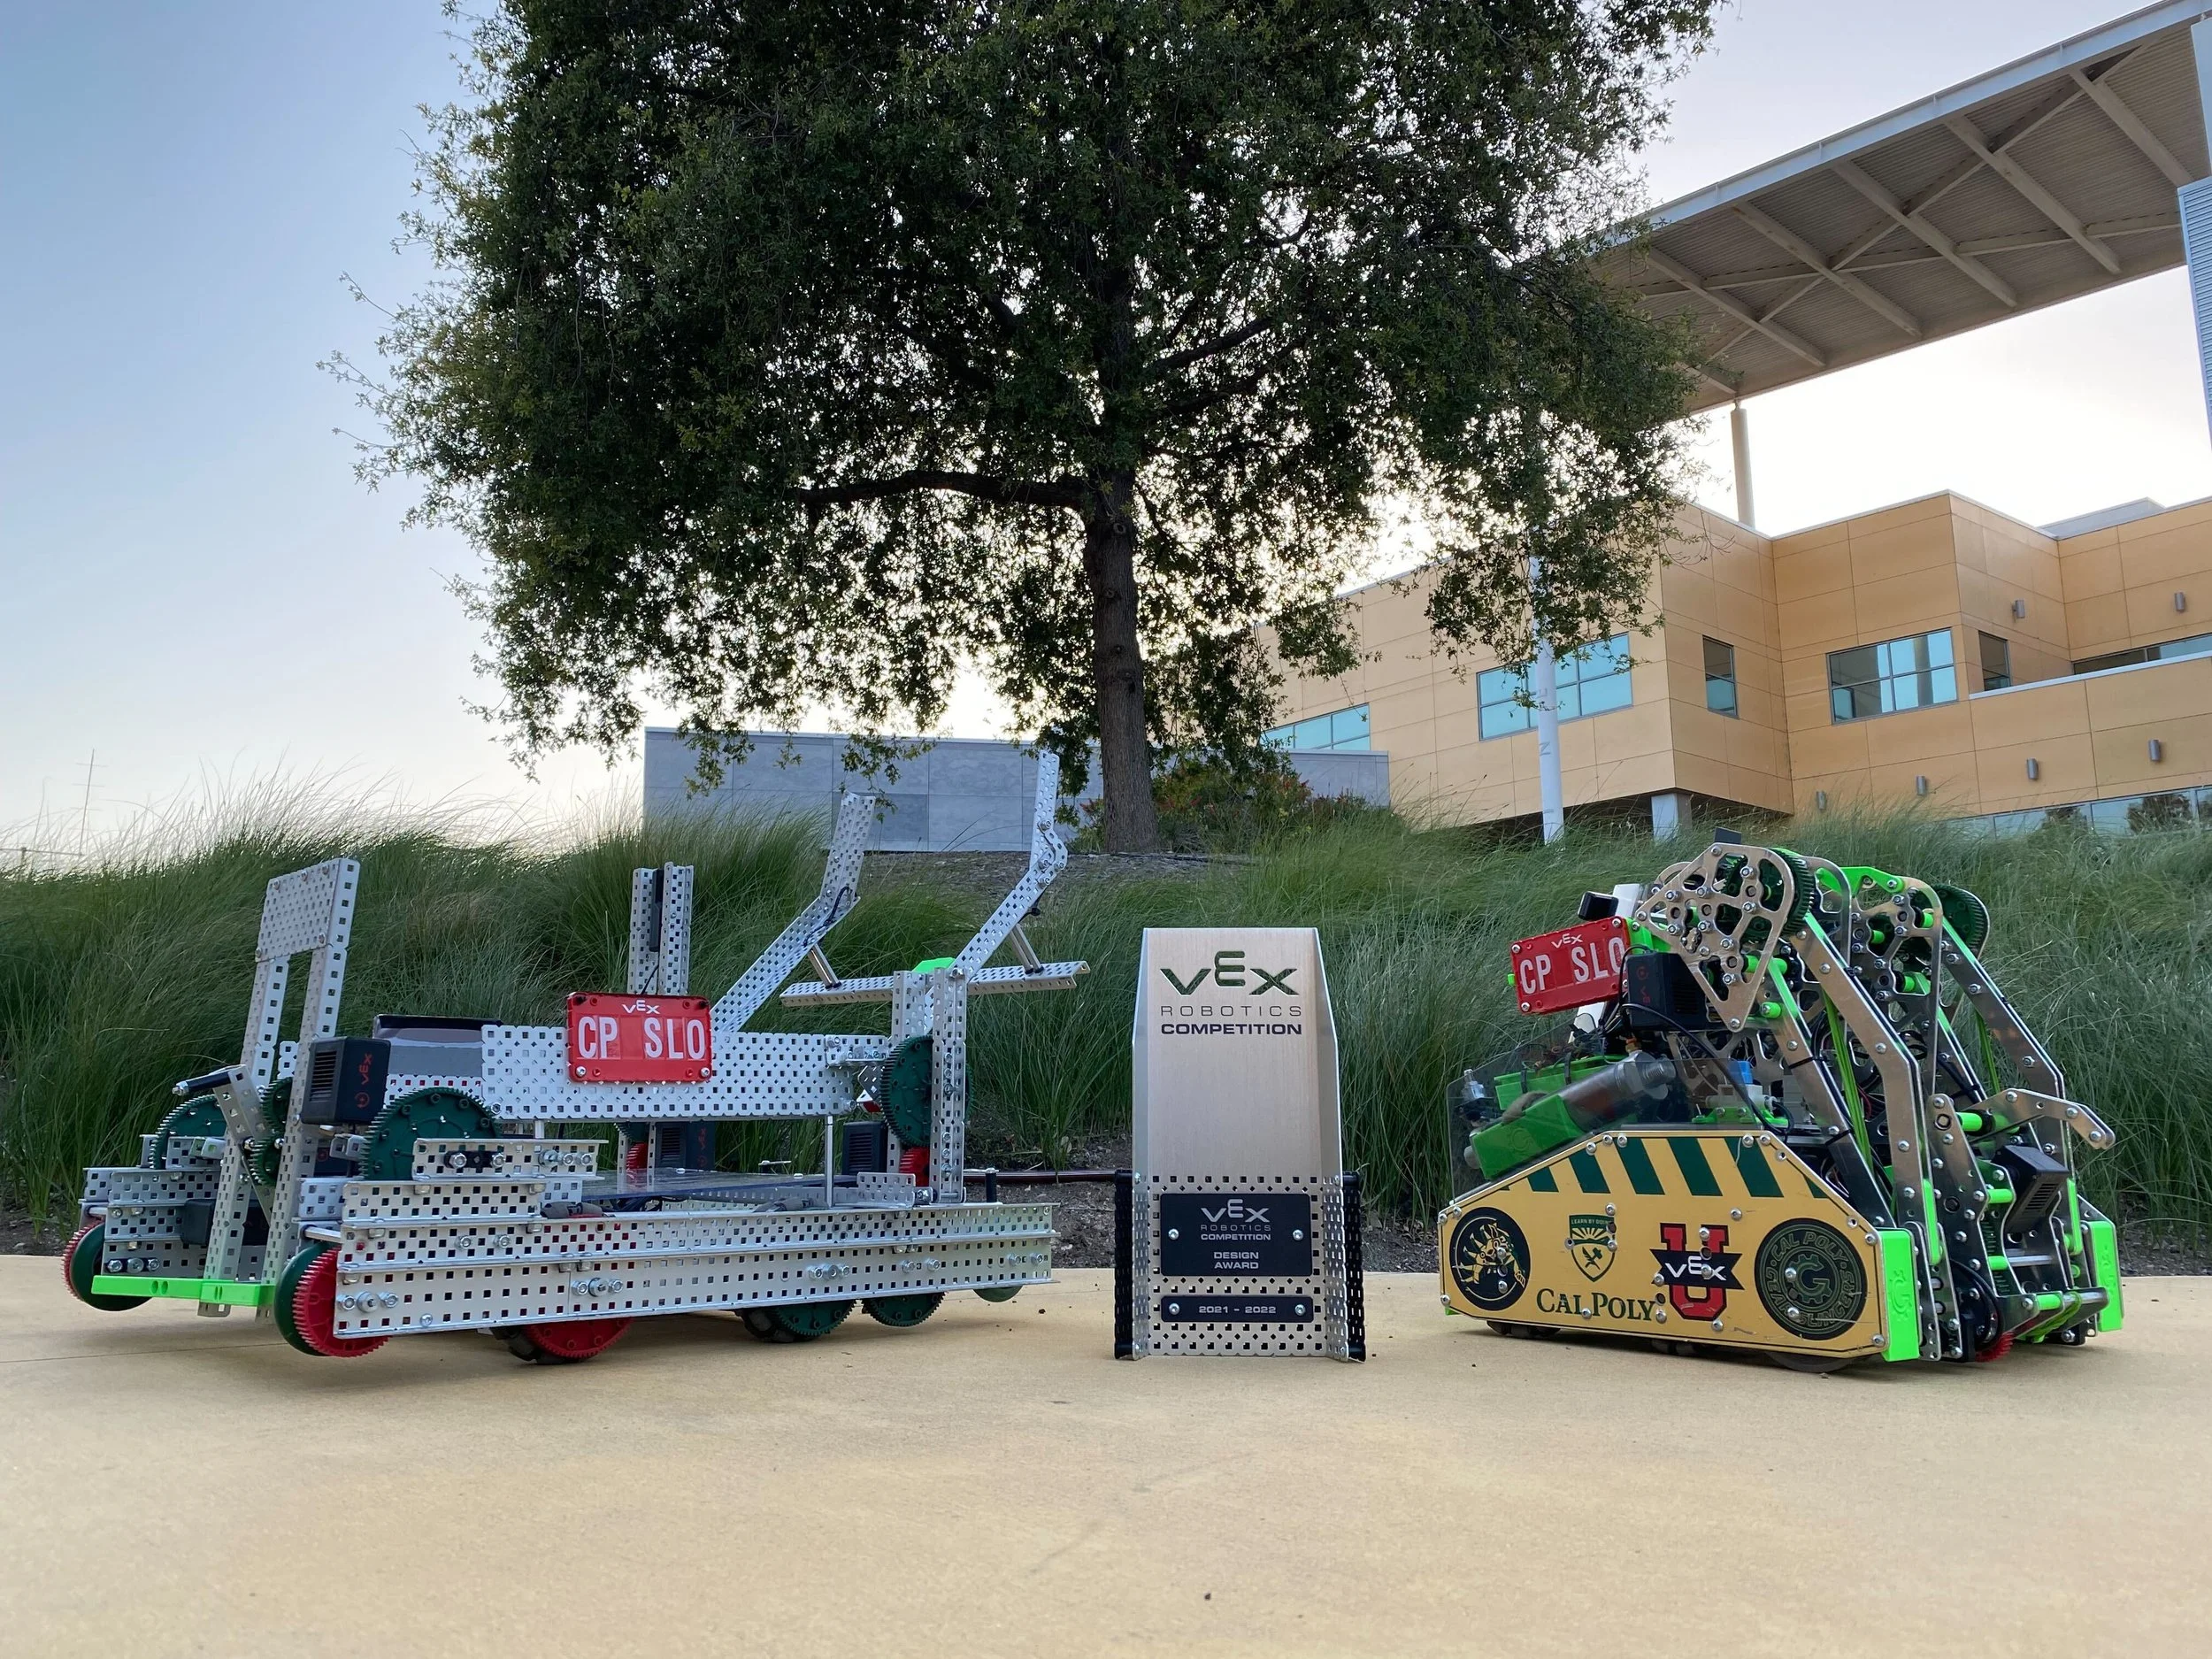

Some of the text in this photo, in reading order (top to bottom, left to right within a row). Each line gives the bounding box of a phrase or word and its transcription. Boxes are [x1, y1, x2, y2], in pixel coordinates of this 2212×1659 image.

[1550, 933, 1584, 949] VEX
[1159, 950, 1300, 995] VEX
[1519, 936, 1626, 995] CP SLO
[621, 999, 661, 1015] VEX
[1160, 1005, 1302, 1017] ROBOTICS
[578, 1016, 706, 1060] CP SLO
[1161, 1023, 1302, 1035] COMPETITION
[358, 1053, 373, 1086] VEX
[1201, 1198, 1271, 1223] VEX
[1213, 1251, 1259, 1260] DESIGN
[1770, 1231, 1849, 1263] CAL POLY
[1664, 1256, 1727, 1281] VEX
[1198, 1305, 1229, 1314] 2021
[1244, 1305, 1277, 1314] 2022
